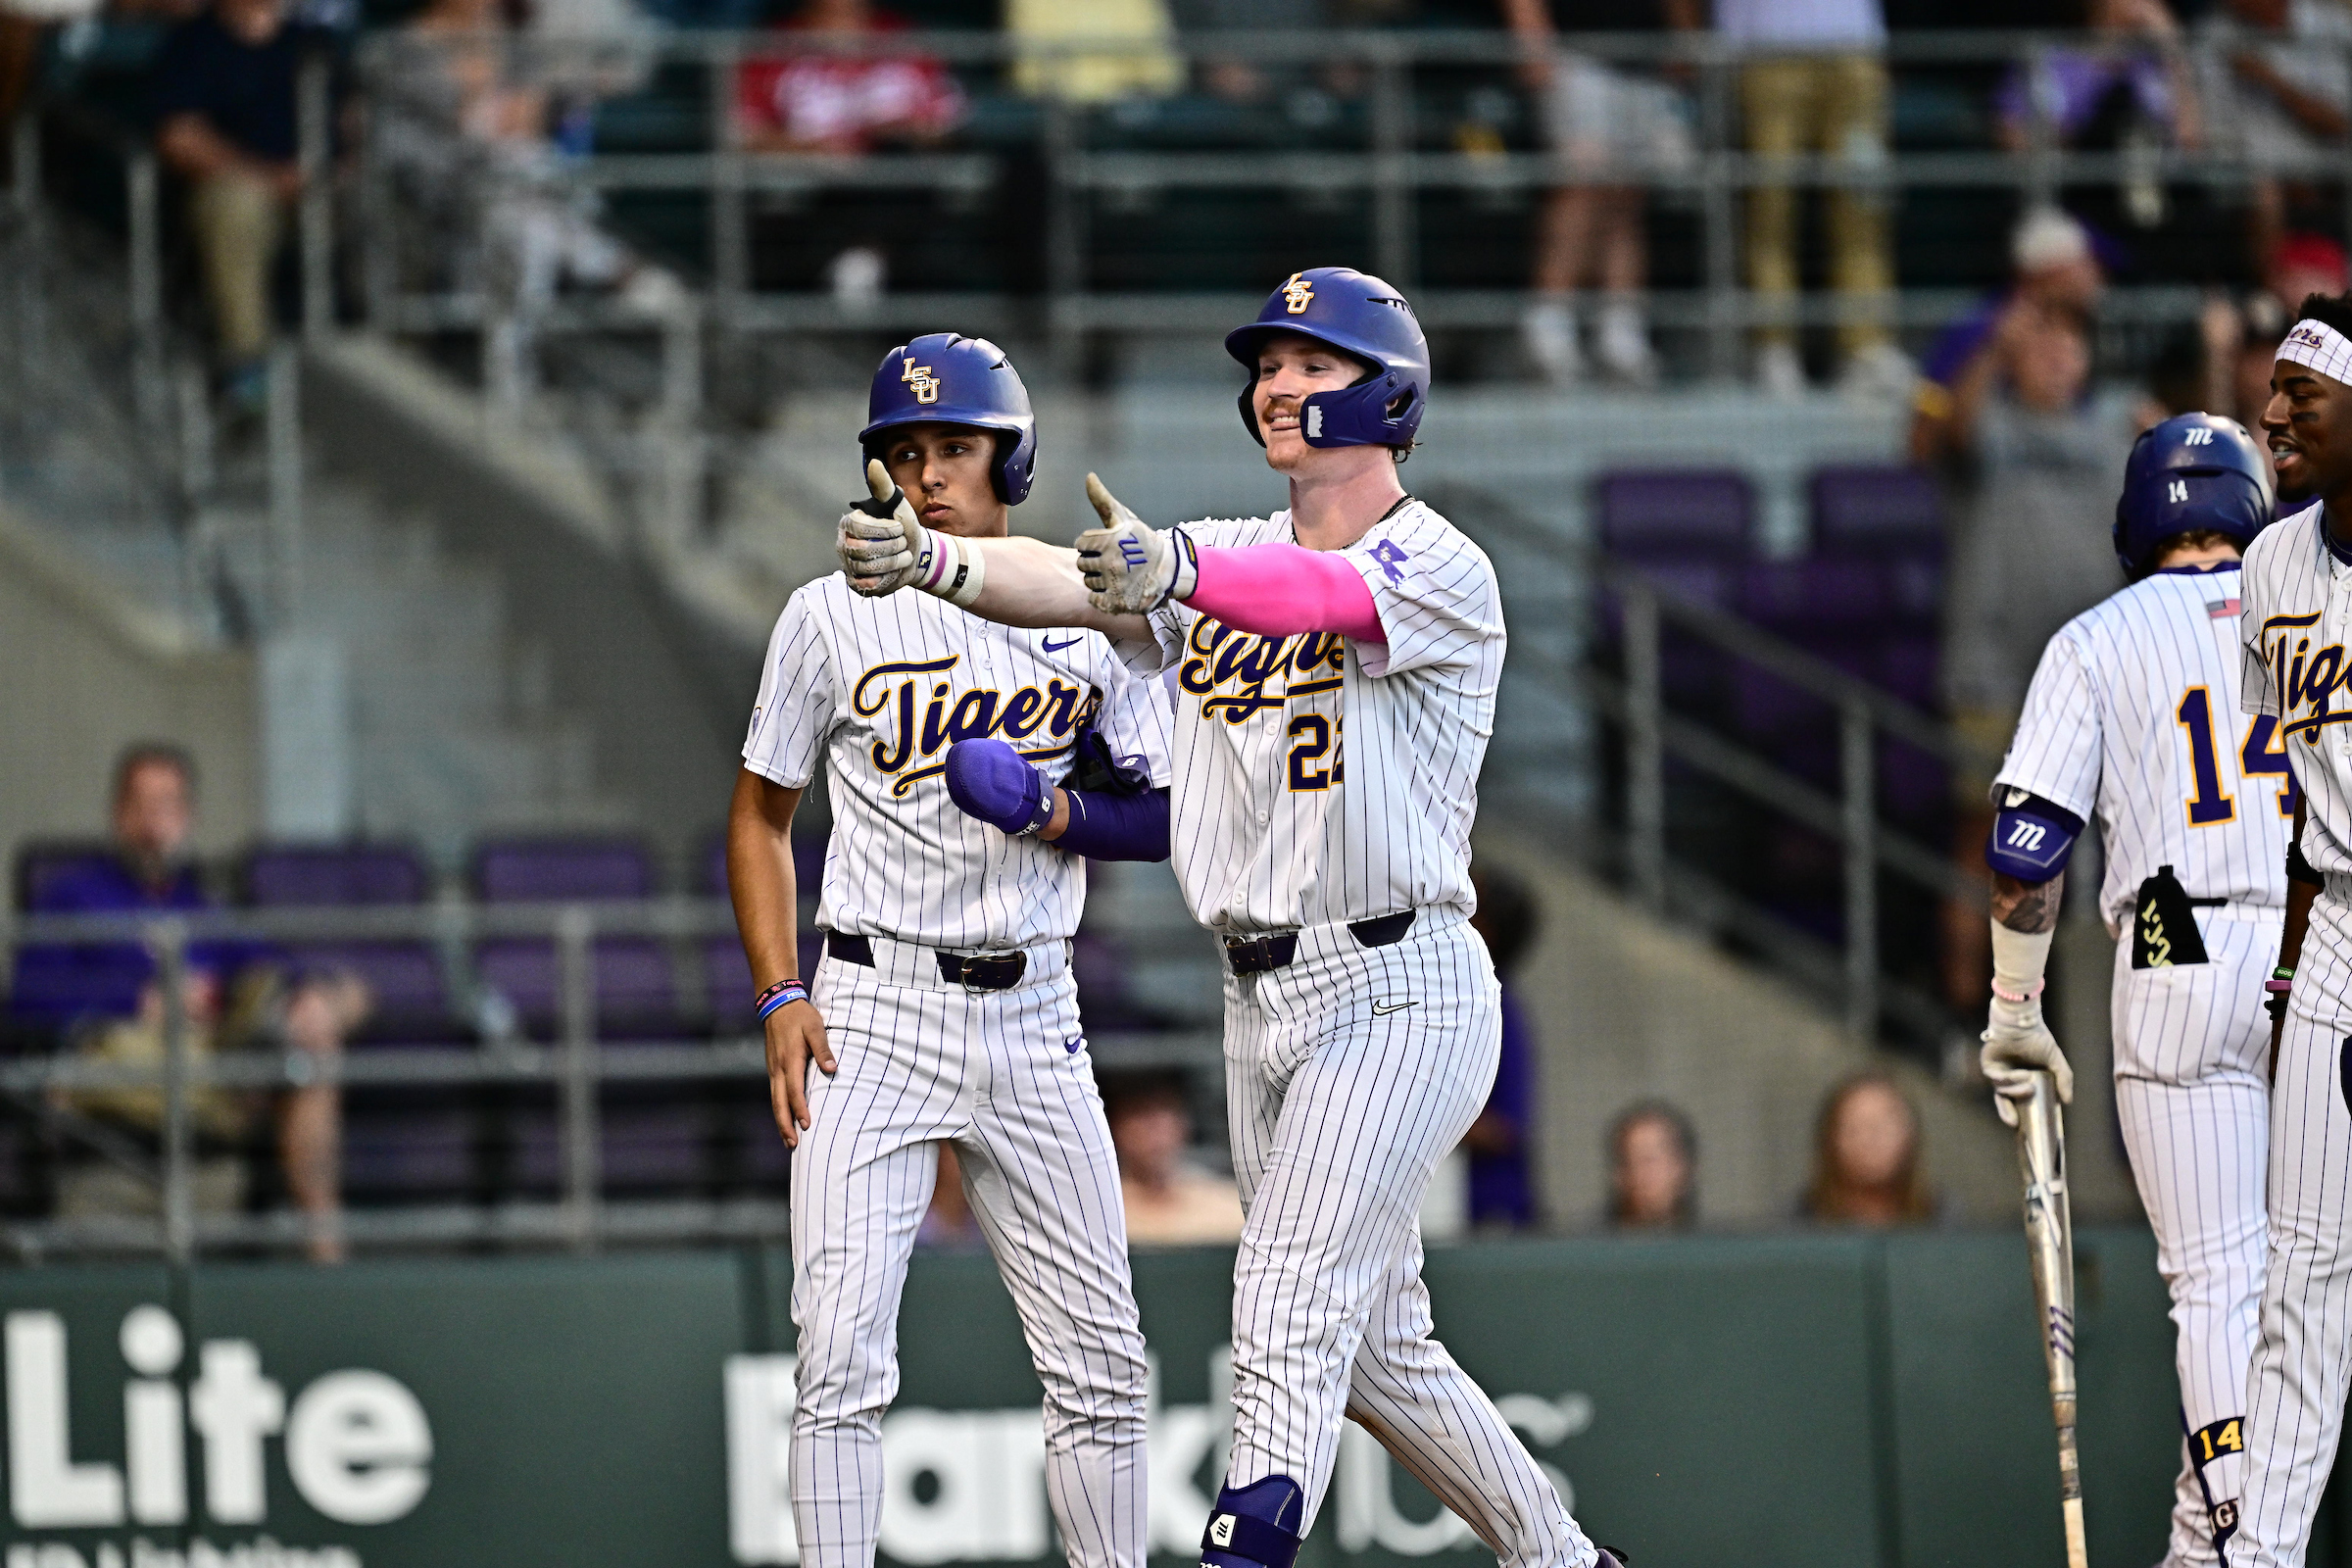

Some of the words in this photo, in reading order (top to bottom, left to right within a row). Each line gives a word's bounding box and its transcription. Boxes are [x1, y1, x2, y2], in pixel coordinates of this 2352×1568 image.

[1282, 271, 1315, 314] LSU
[902, 357, 941, 404] LSU
[2168, 479, 2189, 504] 14
[2176, 684, 2298, 828] 14
[1041, 795, 1053, 814] 6
[4, 1304, 434, 1529] Lite
[723, 1350, 1594, 1565] Banklus
[2199, 1420, 2243, 1461] 14
